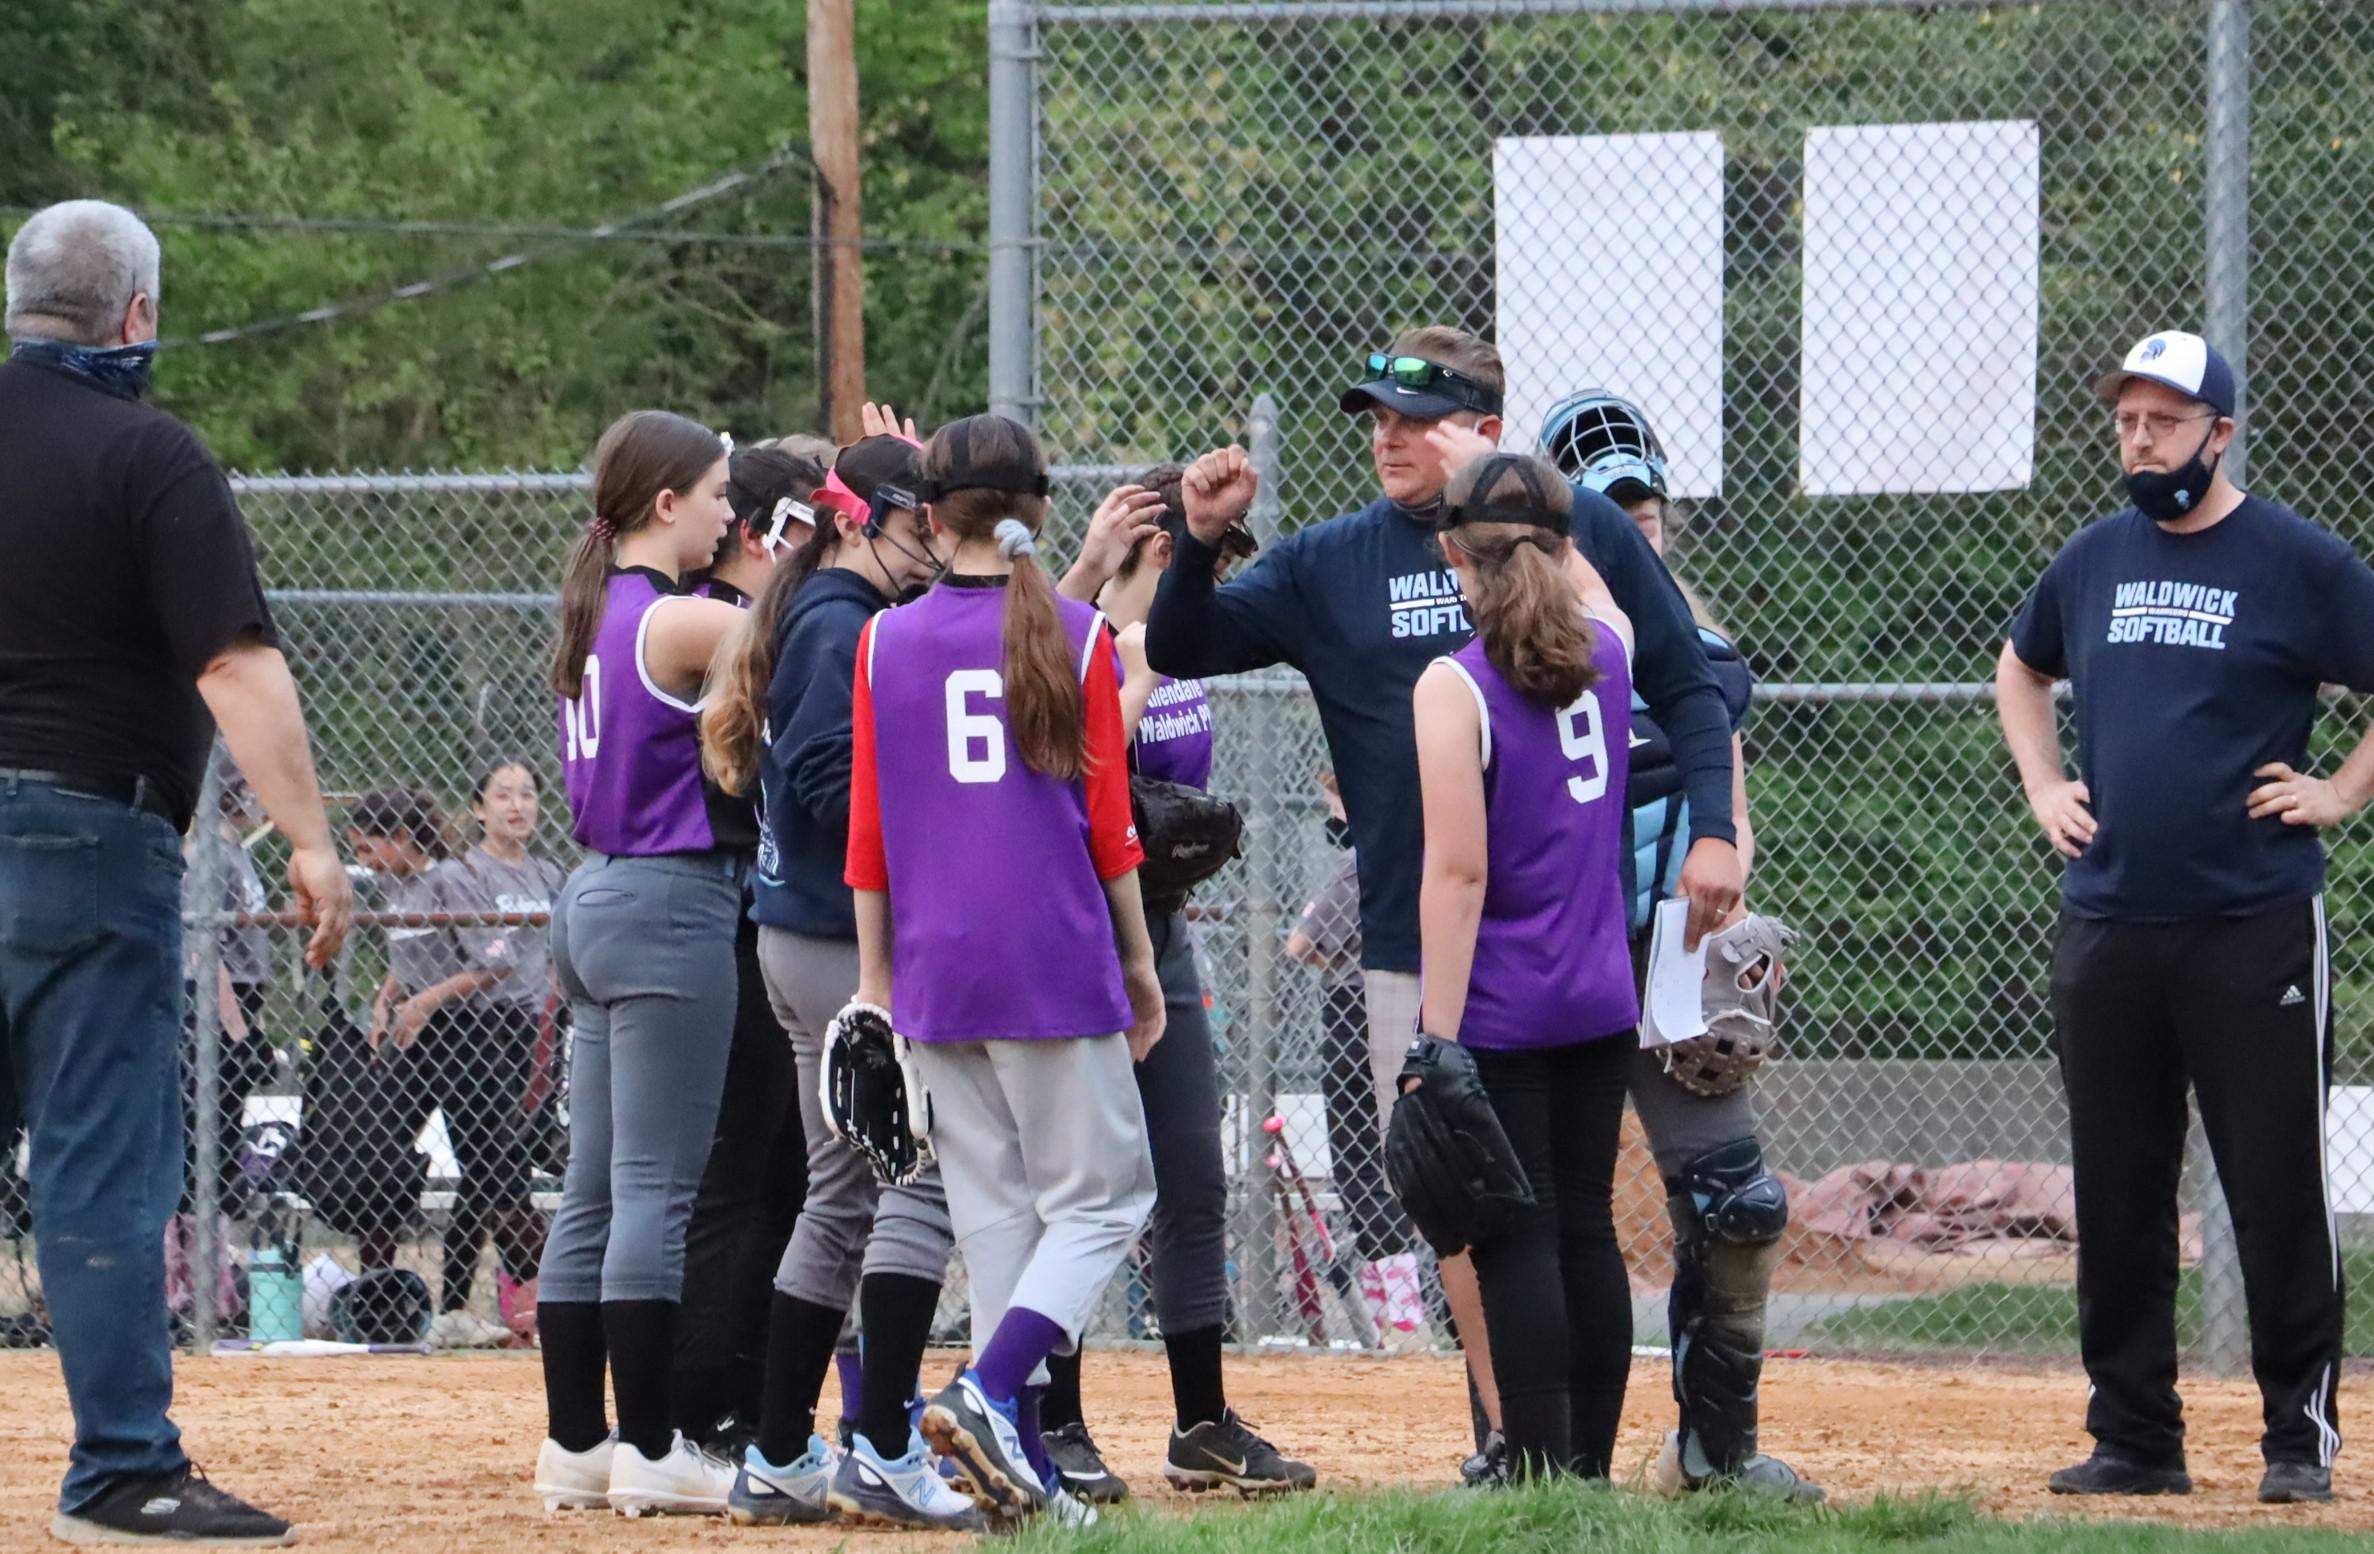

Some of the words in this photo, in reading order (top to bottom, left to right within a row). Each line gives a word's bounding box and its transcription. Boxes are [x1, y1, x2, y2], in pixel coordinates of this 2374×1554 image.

[1388, 568, 1459, 602] WALD
[2114, 580, 2239, 617] WALDWICK
[1391, 604, 1474, 638] SOFT
[2106, 616, 2226, 650] SOFTBALL
[1147, 678, 1204, 708] llendale
[945, 668, 1006, 783] 6
[1138, 707, 1202, 745] Waldwick
[1555, 689, 1608, 804] 9
